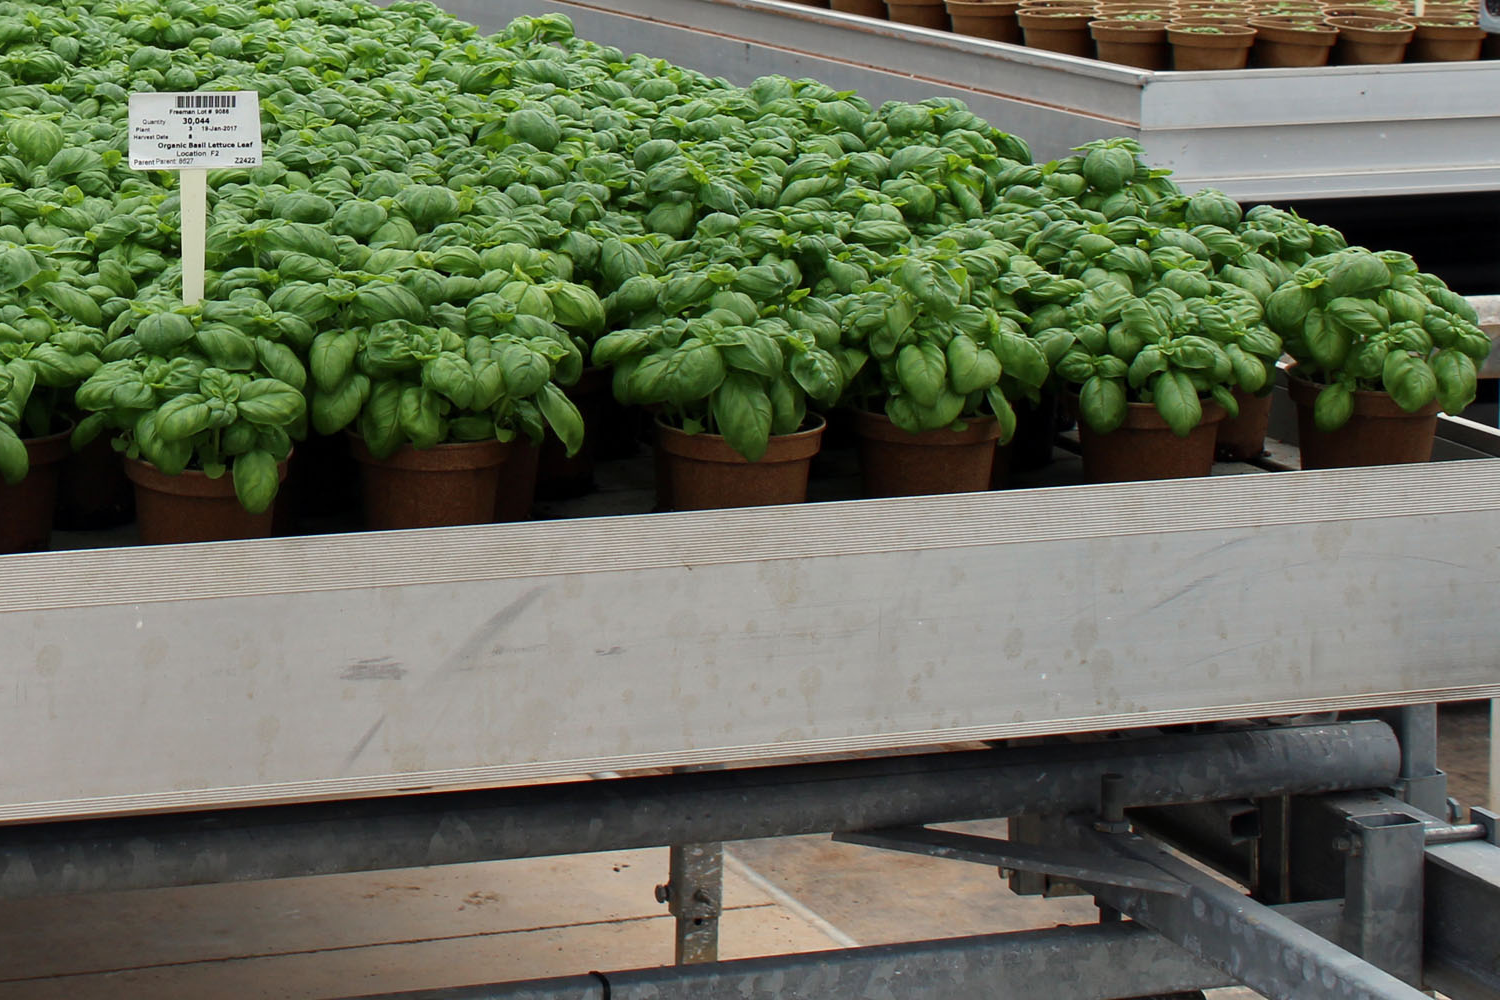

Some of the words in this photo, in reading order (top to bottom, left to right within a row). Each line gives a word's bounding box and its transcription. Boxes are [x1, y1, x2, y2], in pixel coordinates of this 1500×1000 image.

[182, 117, 210, 125] 30,044
[157, 142, 187, 150] Organic
[237, 141, 253, 149] Leaf
